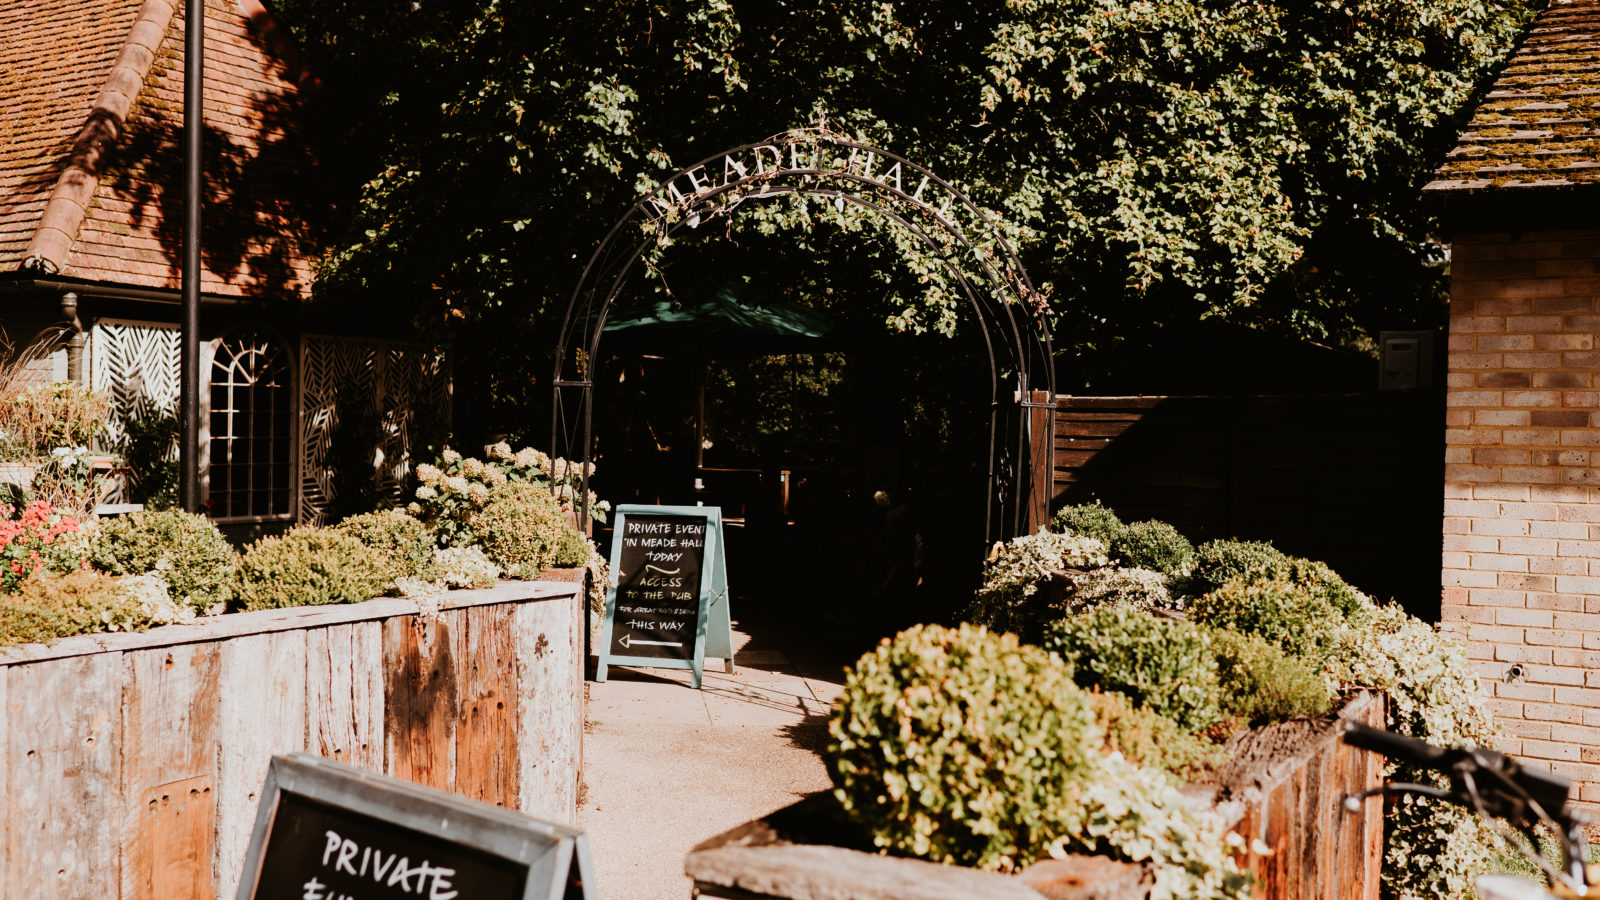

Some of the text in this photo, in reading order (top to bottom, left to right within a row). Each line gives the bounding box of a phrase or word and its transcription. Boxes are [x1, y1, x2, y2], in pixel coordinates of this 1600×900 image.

[646, 143, 812, 217] MEADE
[628, 523, 706, 535] PRIVATE EVENT
[641, 538, 677, 547] MEADE
[680, 538, 703, 547] HALL
[645, 550, 683, 562] TODAY
[640, 577, 683, 588] ACCESS
[626, 590, 692, 601] TO THE PUB
[618, 605, 632, 613] FOR
[634, 606, 657, 614] GREAT
[625, 619, 685, 631] THIS WAY
[322, 830, 458, 900] PRIVATE
